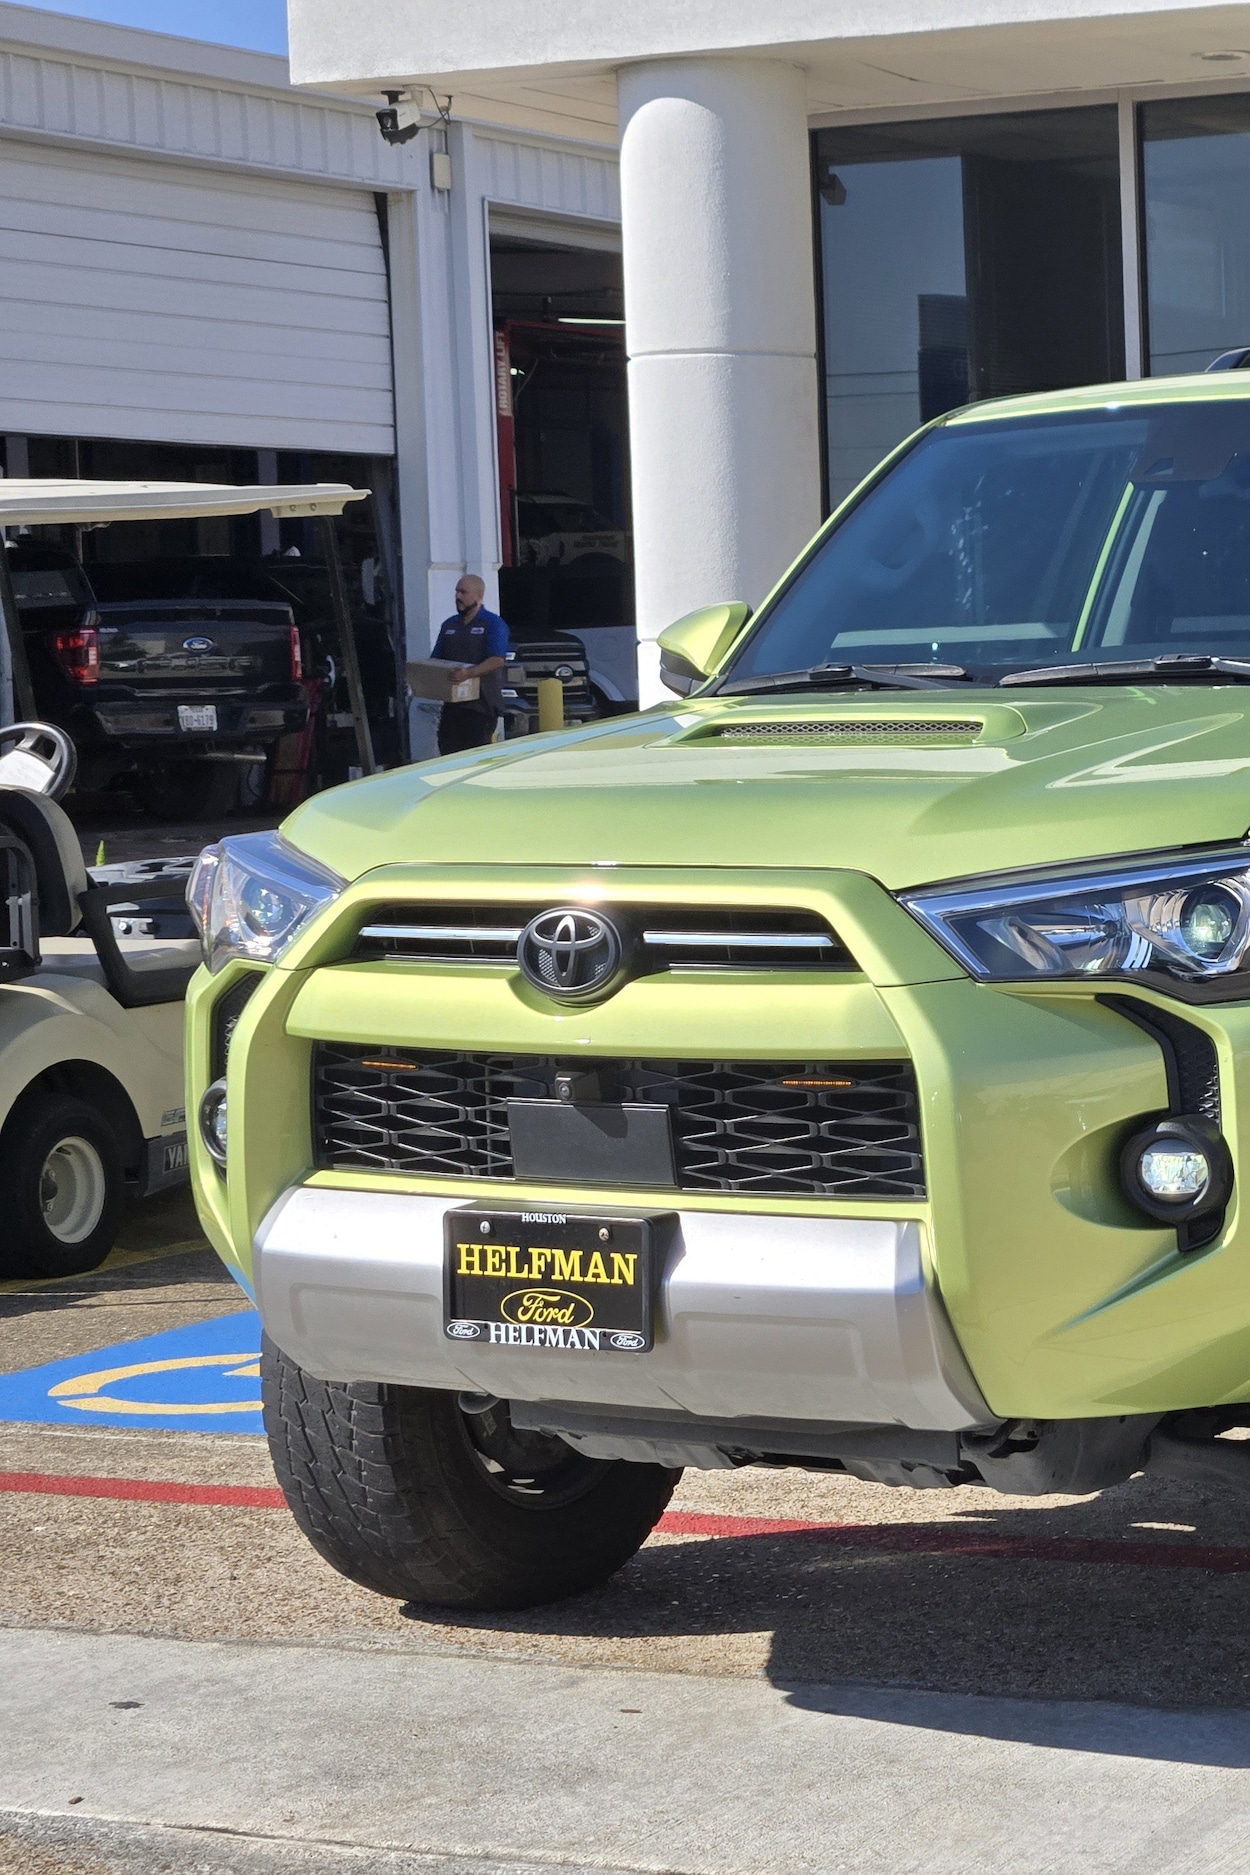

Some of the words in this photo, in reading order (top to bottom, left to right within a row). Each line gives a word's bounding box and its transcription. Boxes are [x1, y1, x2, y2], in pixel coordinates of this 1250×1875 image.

[496, 330, 506, 357] LIFT
[497, 360, 508, 408] ROTARY
[521, 1212, 567, 1224] HOUSTON
[457, 1243, 638, 1285] HELFMAN
[517, 1292, 576, 1325] Ford
[452, 1324, 475, 1336] Ford
[489, 1322, 600, 1350] HELFMAN
[616, 1335, 639, 1347] Ford
